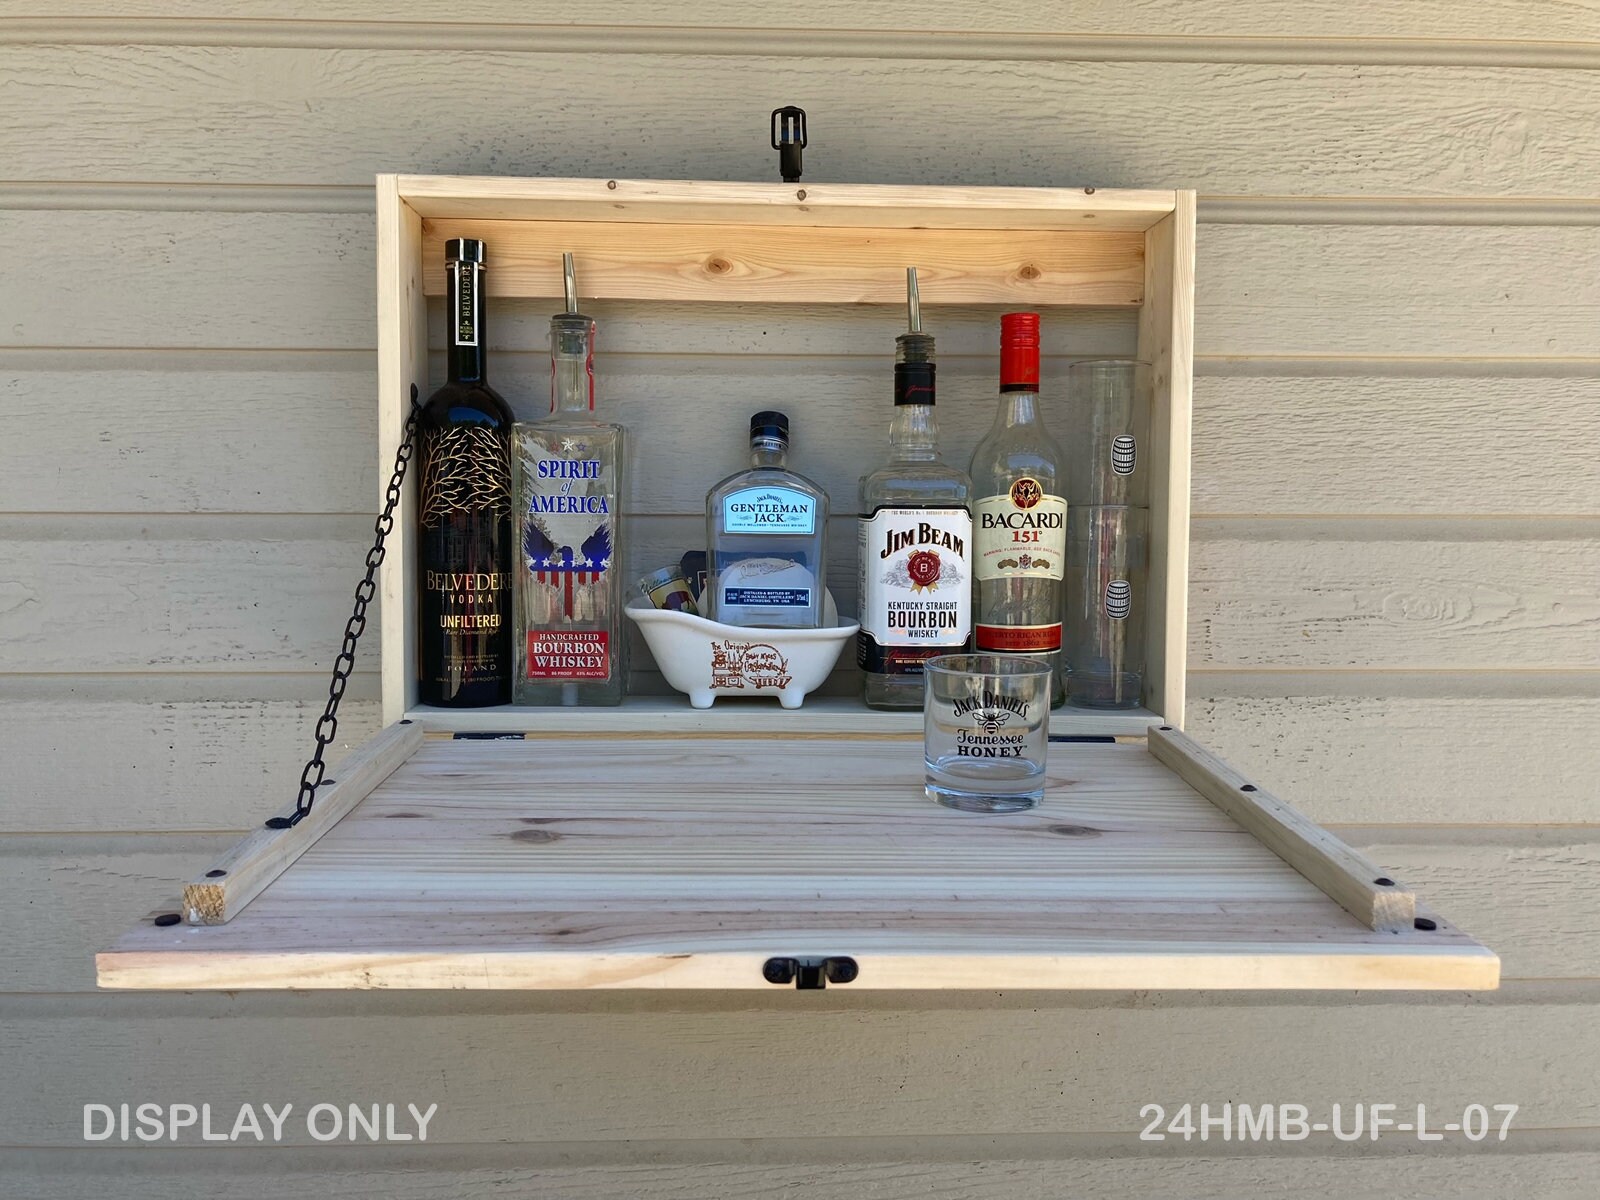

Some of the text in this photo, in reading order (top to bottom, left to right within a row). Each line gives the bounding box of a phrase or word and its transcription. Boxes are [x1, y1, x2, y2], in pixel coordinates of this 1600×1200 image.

[462, 264, 471, 317] BELVEDERE
[538, 459, 600, 479] SPIRIT
[560, 479, 574, 496] of
[528, 495, 609, 514] AMERICA
[730, 503, 808, 513] GENTLEMAN
[754, 513, 785, 524] JACK
[981, 512, 1063, 530] BACARDI
[880, 522, 965, 562] JIM BEAM
[920, 563, 928, 572] B
[450, 594, 493, 604] VODKA
[887, 601, 957, 610] KENTUCKY STRAIGHT
[440, 614, 502, 628] UNFILTERED
[887, 611, 957, 628] BOURBON
[539, 633, 599, 641] HANDCRAFTED
[907, 629, 939, 638] WHISKEY
[533, 642, 606, 654] BOURBON
[724, 639, 752, 654] Original
[534, 655, 604, 668] WHISKEY
[953, 690, 1030, 718] JACK DANIEL'S
[957, 728, 1024, 744] Tennessee
[957, 745, 1024, 758] HONEY
